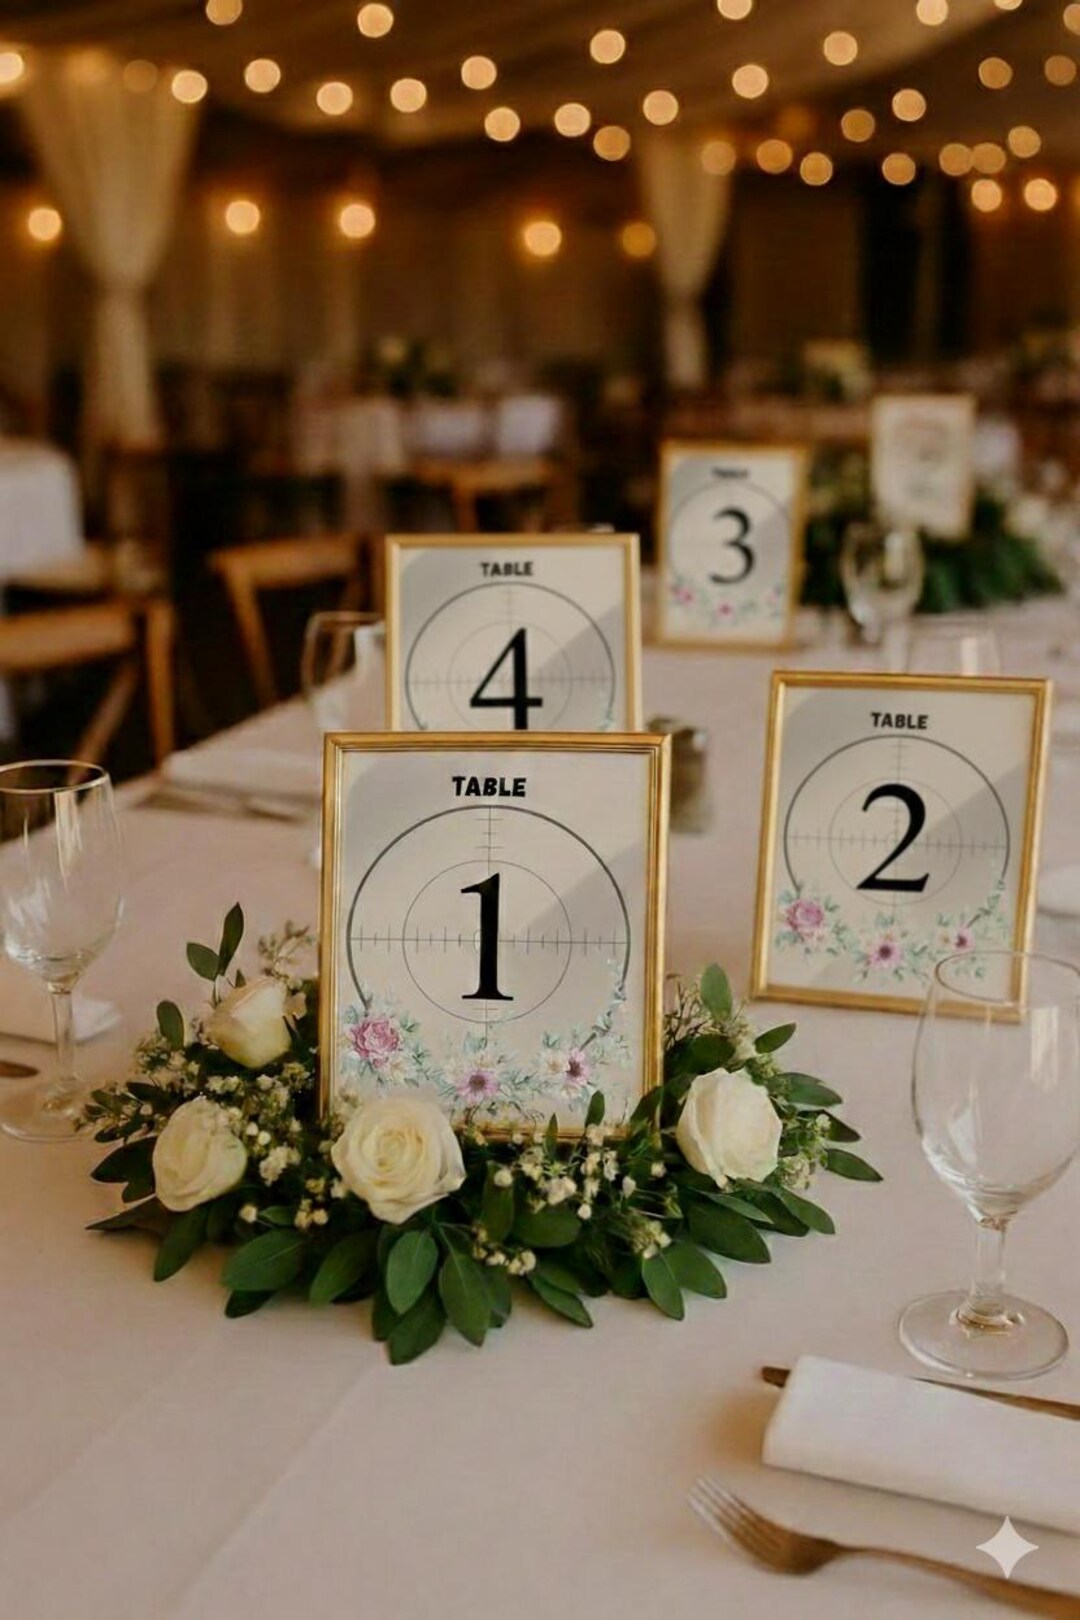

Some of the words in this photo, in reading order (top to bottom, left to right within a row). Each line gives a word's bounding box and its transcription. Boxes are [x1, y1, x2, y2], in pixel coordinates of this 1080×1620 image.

[480, 561, 533, 577] TABLE
[711, 507, 755, 584] 3
[469, 627, 544, 730] 4
[870, 711, 929, 730] TABLE
[451, 775, 527, 798] TABLE
[855, 783, 930, 893] 2
[460, 872, 514, 1001] 1
